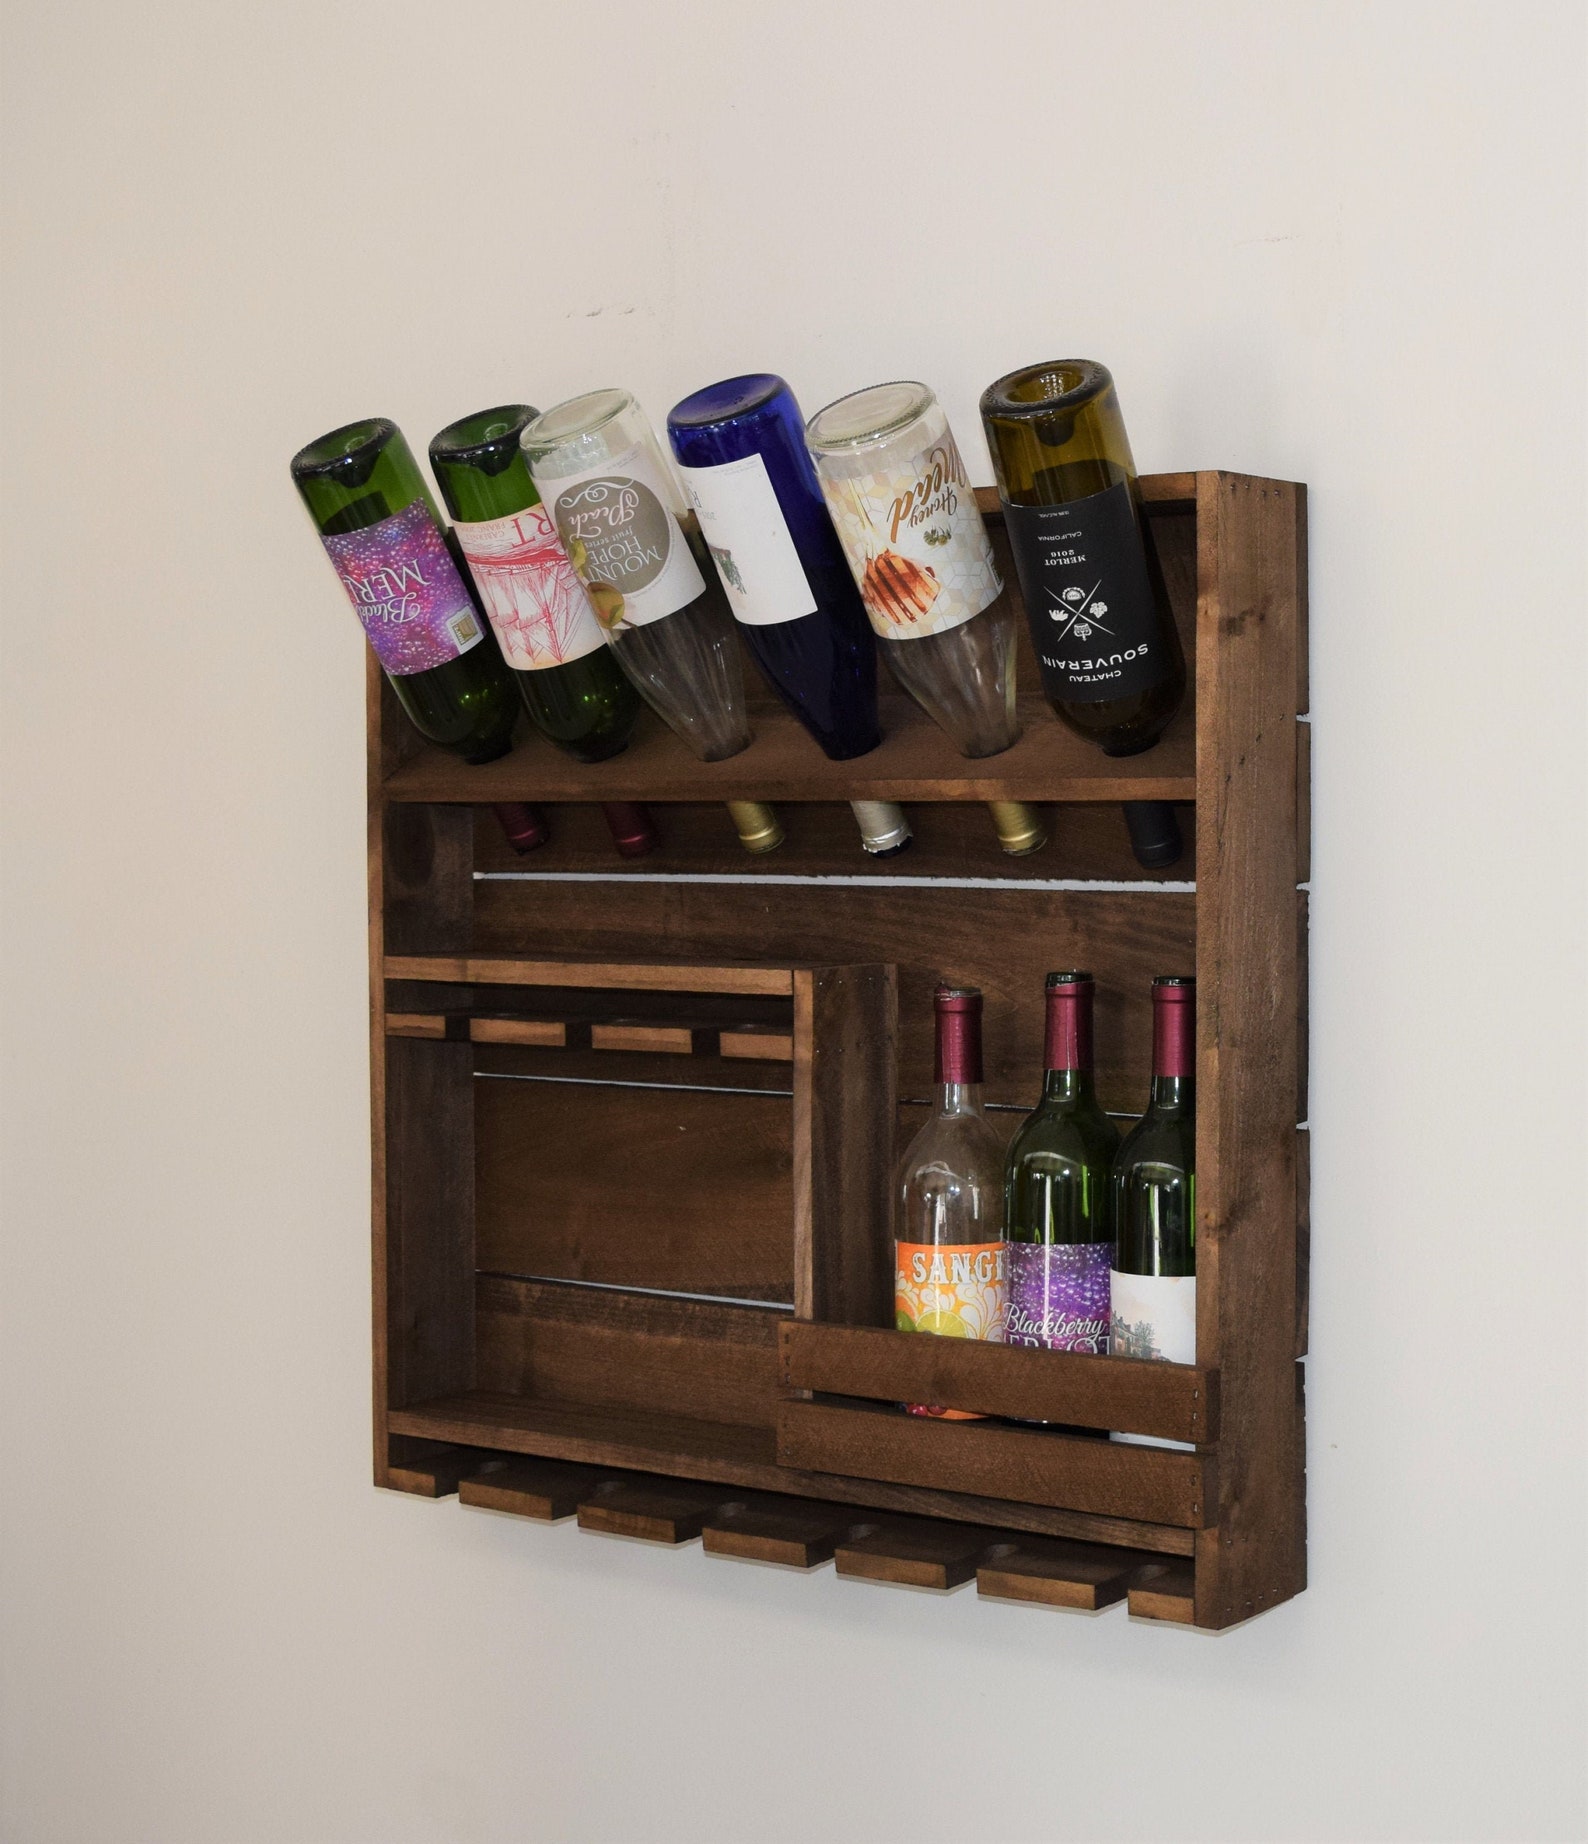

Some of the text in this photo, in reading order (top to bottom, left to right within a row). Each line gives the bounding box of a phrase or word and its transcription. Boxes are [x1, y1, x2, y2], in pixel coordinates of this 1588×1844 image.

[568, 487, 640, 544] Peach
[906, 485, 958, 529] Honey
[480, 521, 505, 532] FRANC
[585, 525, 634, 547] fruit series
[1038, 531, 1082, 541] CALIFORNIA
[590, 535, 642, 564] HOPE
[1044, 554, 1087, 567] MERLOT
[1050, 549, 1075, 558] 2016
[588, 544, 663, 583] MOUNT
[1041, 643, 1149, 671] SOUVERAIN
[1068, 670, 1122, 683] CHATEAU
[1002, 1302, 1106, 1342] Blackberry
